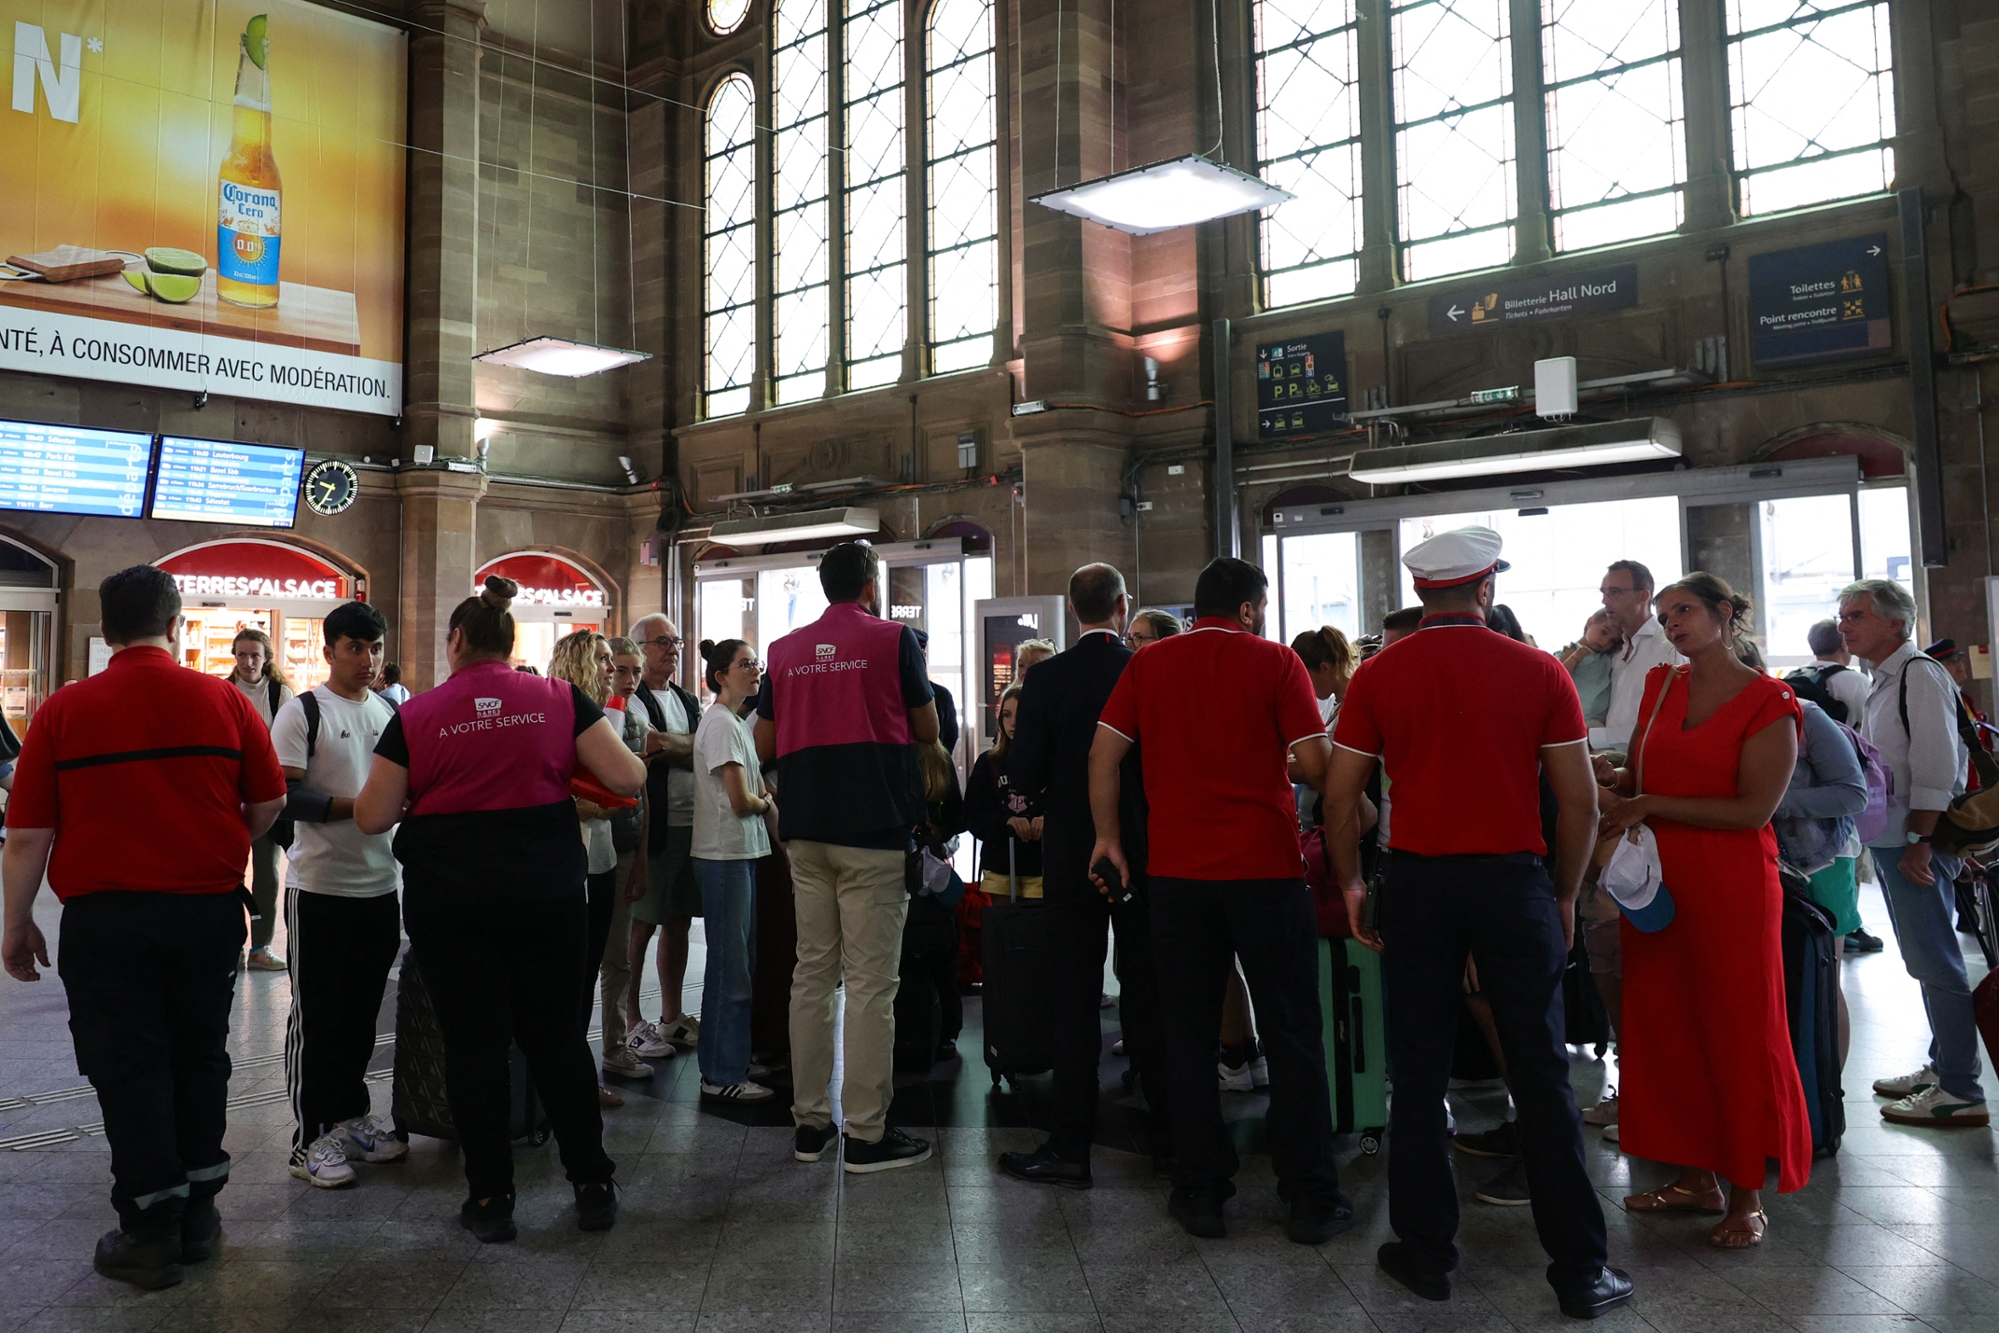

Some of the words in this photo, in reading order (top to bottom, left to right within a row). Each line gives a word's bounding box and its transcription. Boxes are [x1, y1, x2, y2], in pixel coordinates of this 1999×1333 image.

[223, 183, 278, 208] Corona
[238, 203, 264, 218] Cero
[1790, 281, 1835, 294] Toilettes
[1505, 296, 1547, 310] Billetterie
[1550, 286, 1577, 302] Hall
[1581, 281, 1617, 297] Nord
[1506, 311, 1528, 320] Tickets
[1760, 315, 1785, 325] Point
[1788, 307, 1837, 321] rencontre
[1287, 343, 1307, 353] Sortie
[50, 330, 64, 356] À
[72, 338, 210, 374] CONSOMMER
[215, 357, 263, 382] AVEC
[270, 366, 390, 399] MODÉRATION.
[45, 452, 63, 460] Paris
[64, 453, 76, 461] Est
[212, 451, 249, 462] Lauterbourg
[210, 466, 227, 475] Basel
[227, 468, 239, 476] Sbb
[118, 445, 142, 516] départs
[272, 453, 296, 518] départs
[38, 501, 54, 509] Barr
[817, 646, 835, 655] SNCF
[788, 668, 794, 678] A
[795, 663, 828, 675] VOTRE
[830, 659, 868, 672] SERVICE
[477, 700, 500, 710] SNCF
[439, 727, 448, 738] A
[450, 719, 493, 735] VOTRE
[496, 713, 546, 728] SERVICE
